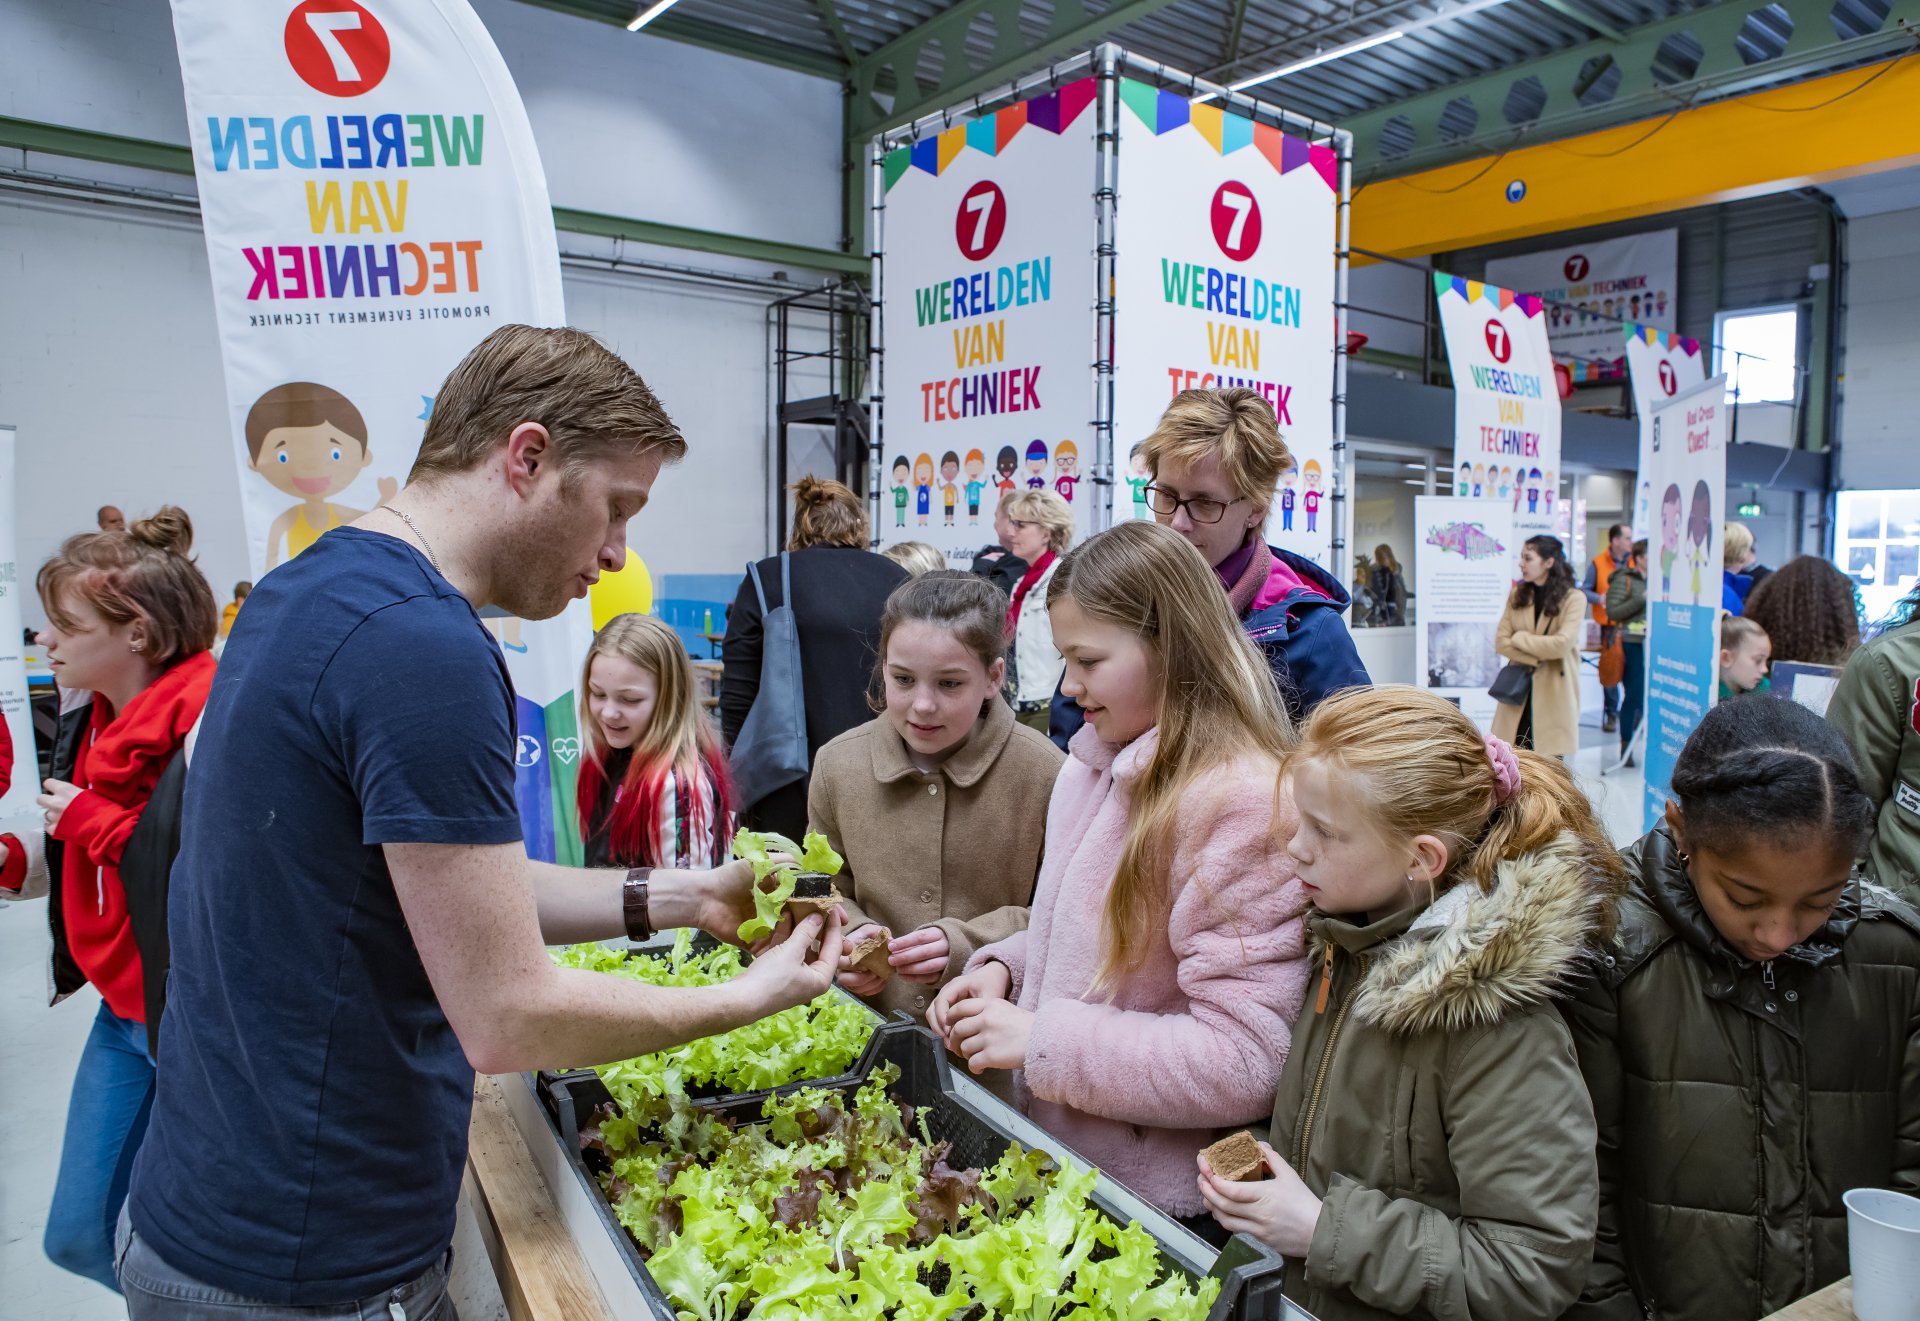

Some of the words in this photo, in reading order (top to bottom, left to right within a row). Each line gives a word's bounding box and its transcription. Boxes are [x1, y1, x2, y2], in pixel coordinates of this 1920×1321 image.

[966, 190, 996, 252] 7
[1222, 190, 1252, 251] 7
[1569, 258, 1585, 280] 7
[1593, 275, 1648, 296] TECHNIEK
[915, 256, 1052, 327] WERELDEN
[1160, 257, 1301, 329] WERELDEN
[953, 319, 1005, 369] VAN
[1206, 320, 1260, 372] VAN
[1488, 324, 1505, 359] 7
[921, 365, 1042, 423] TECHNIEK
[1470, 364, 1542, 399] WERELDEN
[1660, 364, 1673, 394] 7
[1498, 398, 1525, 426] VAN
[1480, 426, 1540, 459] TECHNIEK
